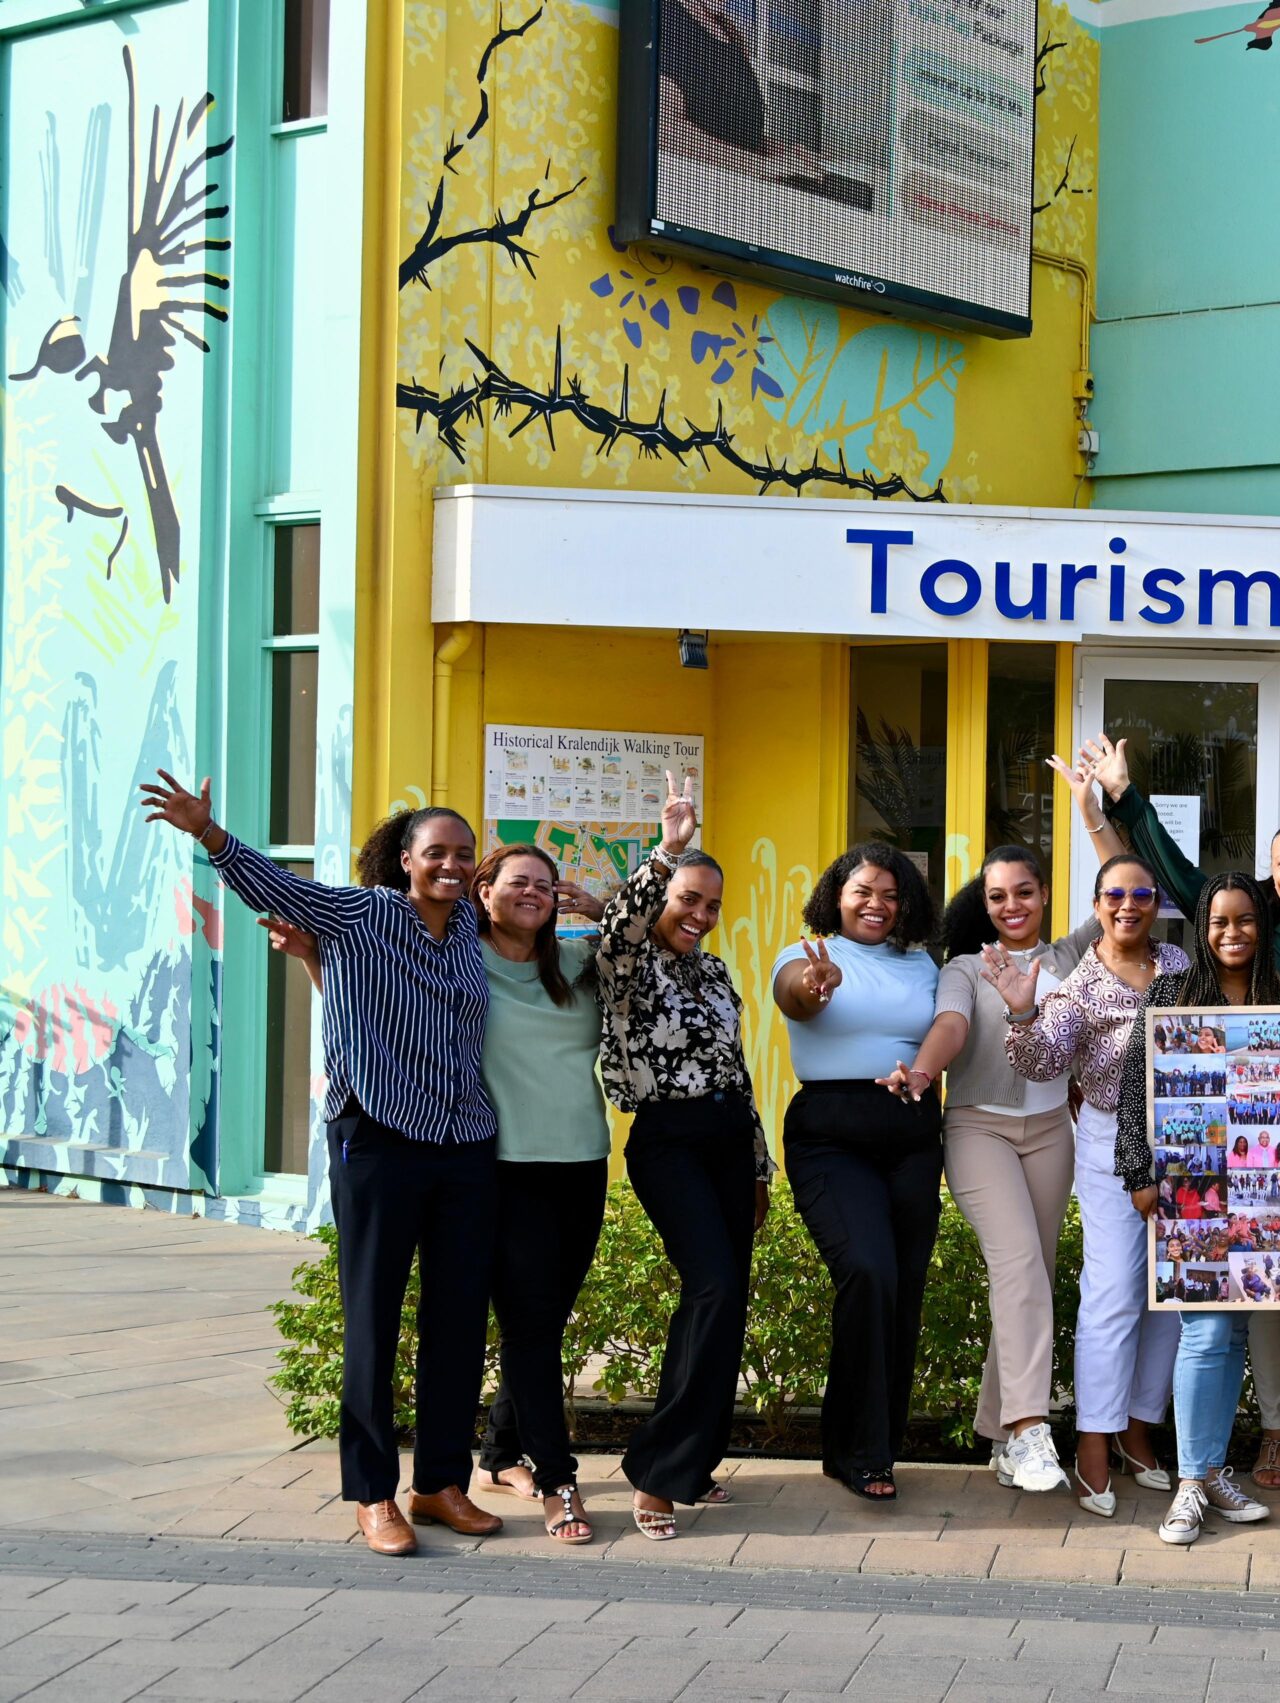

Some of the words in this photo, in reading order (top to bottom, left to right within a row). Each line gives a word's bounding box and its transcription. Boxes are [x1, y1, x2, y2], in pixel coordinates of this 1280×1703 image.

[835, 273, 872, 291] watchfire
[493, 731, 553, 749] Historical
[557, 735, 620, 754] Kralendijk
[624, 739, 670, 759] Walking
[673, 741, 700, 757] Tour
